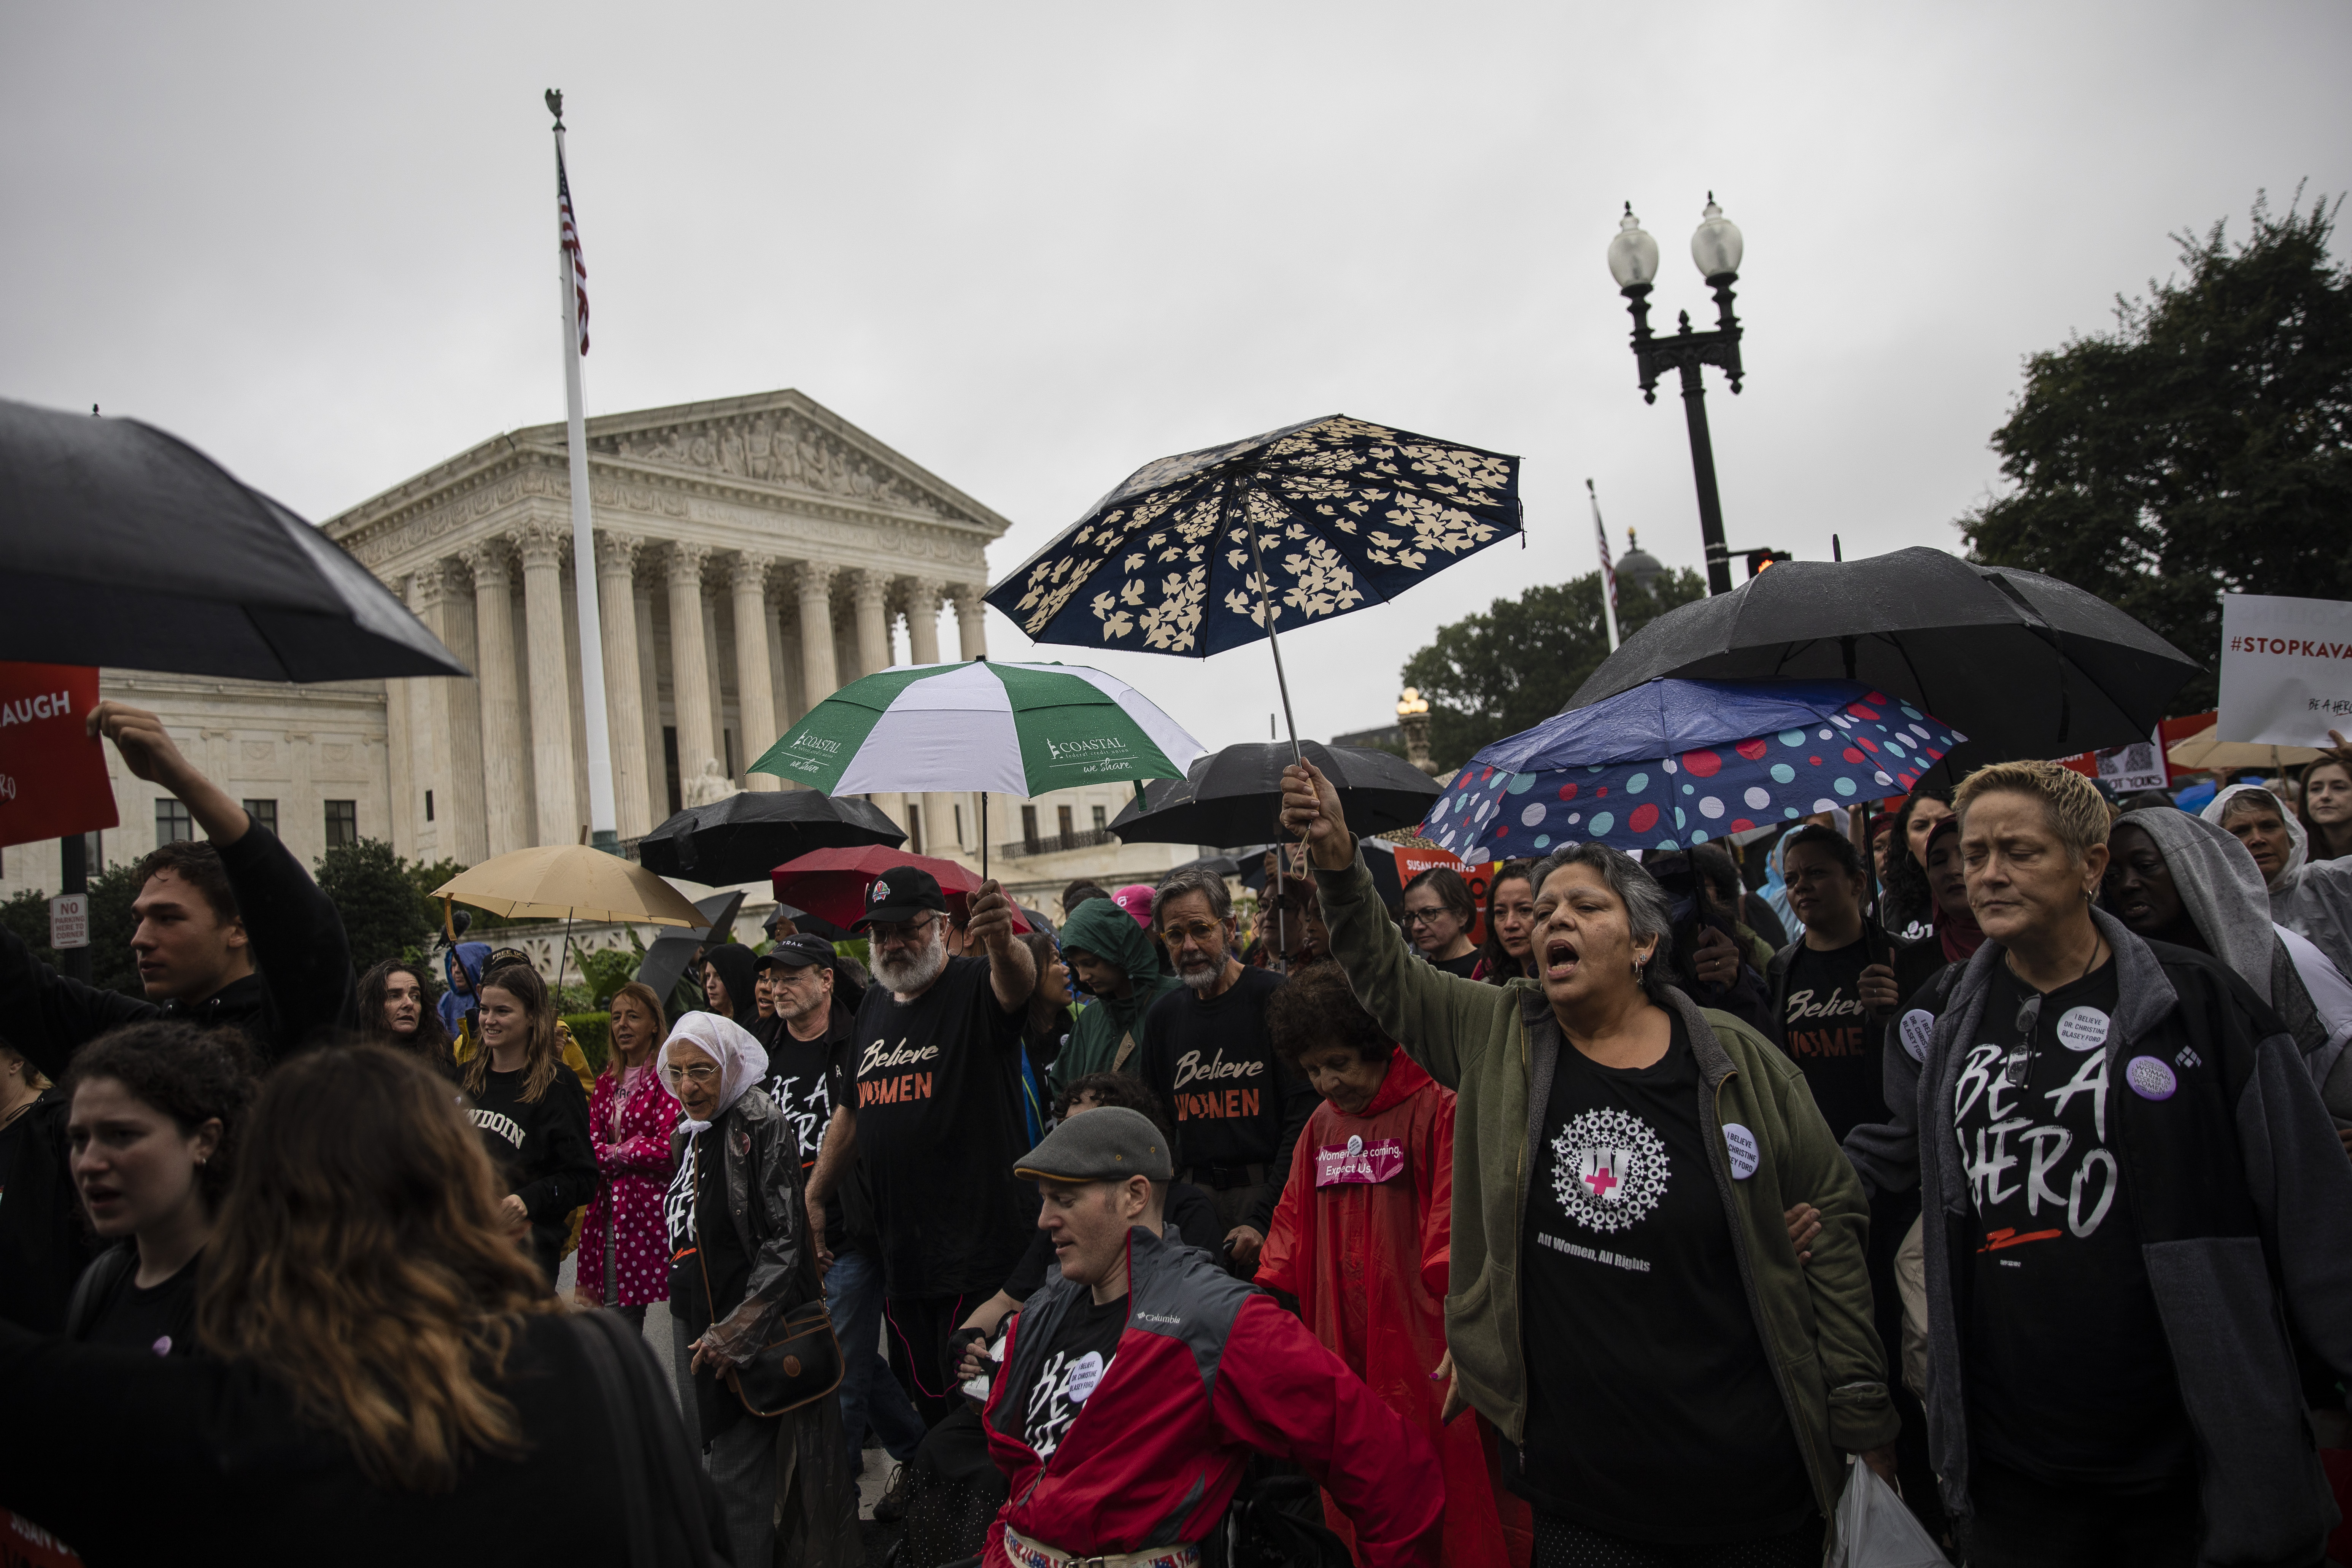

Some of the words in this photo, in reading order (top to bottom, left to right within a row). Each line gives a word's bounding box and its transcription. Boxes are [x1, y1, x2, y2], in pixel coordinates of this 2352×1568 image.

[0, 690, 71, 727] AUGH
[2308, 698, 2320, 710] BE
[2321, 699, 2330, 712] A
[802, 736, 842, 753] COASTAL
[1060, 737, 1126, 752] COASTAL
[1100, 758, 1132, 772] share.
[1406, 859, 1432, 872] SUSAN
[60, 902, 79, 915] NO
[55, 915, 85, 924] PARKING
[56, 930, 84, 939] CORNER
[2078, 1015, 2102, 1025] BELIEVE
[2061, 1030, 2085, 1039] BLASEY
[2075, 1024, 2106, 1034] CHRISTINE
[1902, 1020, 1917, 1044] BLASEY
[1914, 1045, 1925, 1061] FORD
[857, 1037, 939, 1082] Believe
[1174, 1048, 1263, 1090] Believe
[2136, 1064, 2170, 1081] WOMAN
[2139, 1061, 2169, 1075] SUCCESSFUL
[2131, 1072, 2169, 1089] SUCCESSFUL
[2145, 1073, 2162, 1082] TRIBE
[857, 1072, 932, 1109] WOMEN
[2134, 1077, 2165, 1093] WOMEN
[771, 1075, 800, 1114] BE
[803, 1072, 831, 1117] A
[1954, 1044, 2041, 1127] BE
[2045, 1047, 2109, 1143] A
[1730, 1133, 1752, 1149] BELIEVE
[1317, 1151, 1349, 1161] Women
[1370, 1145, 1401, 1158] coming.
[1728, 1144, 1756, 1163] CHRISTINE
[1326, 1165, 1356, 1176] Expect
[1357, 1163, 1373, 1173] Us.
[1739, 1160, 1753, 1172] FORD
[1956, 1117, 2117, 1238] HERO
[1537, 1232, 1552, 1247] All
[1553, 1237, 1597, 1261] Women,
[1598, 1249, 1613, 1265] All
[1615, 1253, 1650, 1272] Rights
[1146, 1314, 1180, 1323] Columbia
[1080, 1360, 1095, 1369] BELIEVE
[1077, 1370, 1097, 1380] CHRISTINE
[1070, 1382, 1084, 1392] BLASEY
